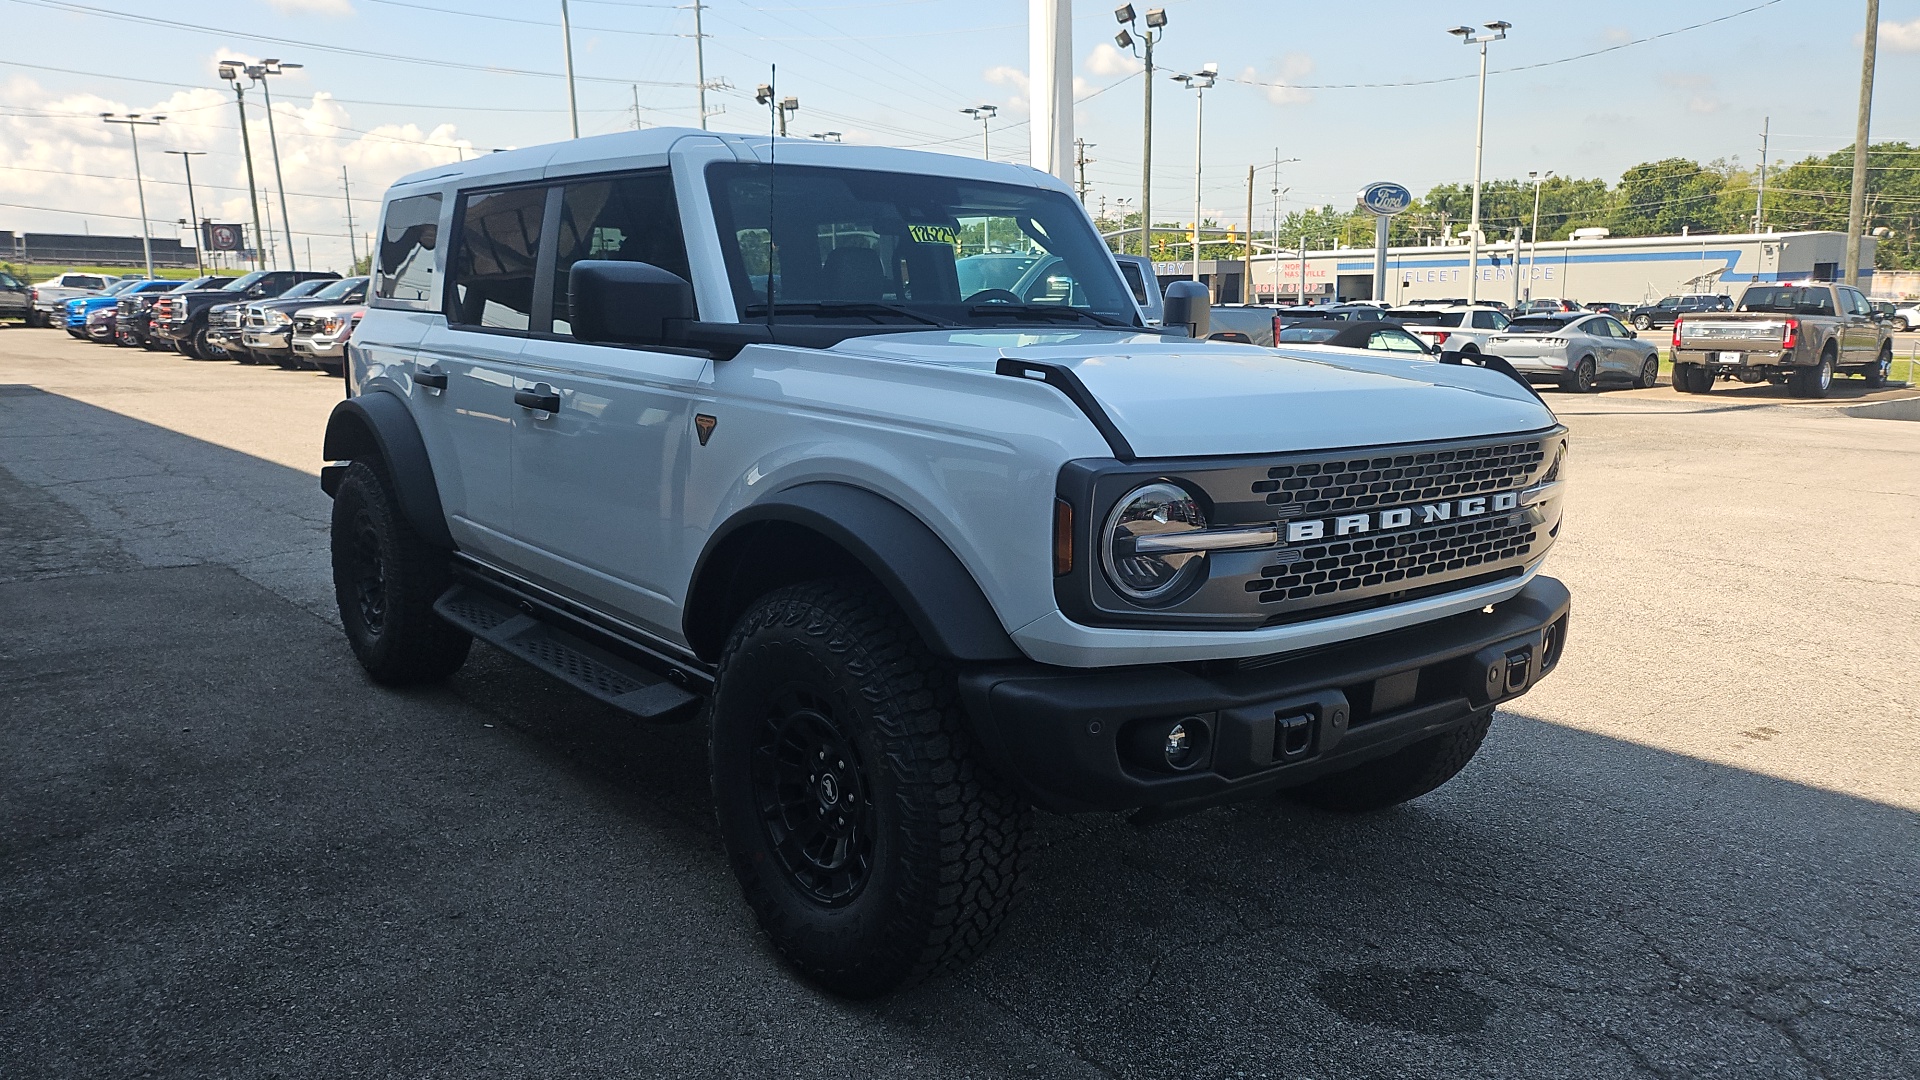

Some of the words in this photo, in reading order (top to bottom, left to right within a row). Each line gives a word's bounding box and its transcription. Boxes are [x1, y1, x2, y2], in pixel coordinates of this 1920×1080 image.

[1374, 188, 1404, 208] Ford
[1284, 263, 1311, 271] NORH
[1284, 270, 1327, 278] NASVILLE
[1404, 269, 1461, 283] FLEET
[1286, 491, 1517, 543] BRONCO
